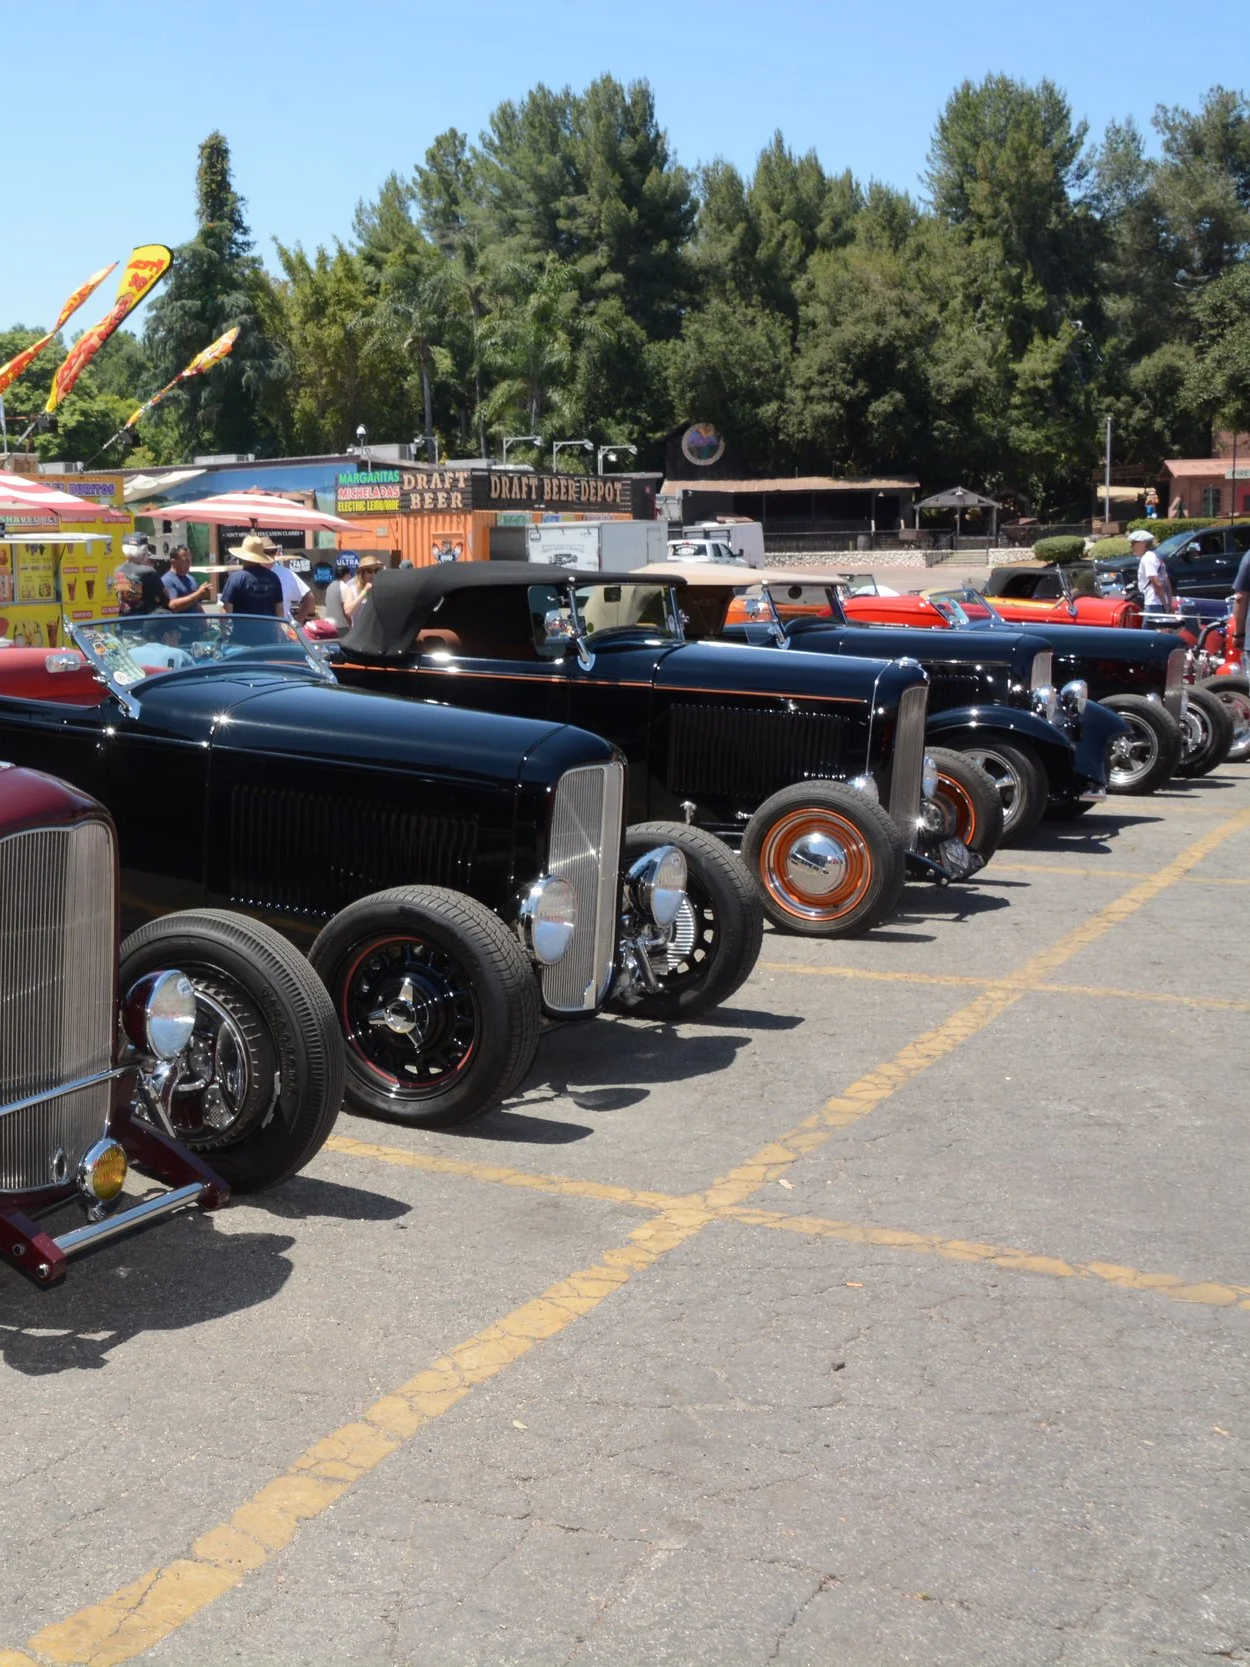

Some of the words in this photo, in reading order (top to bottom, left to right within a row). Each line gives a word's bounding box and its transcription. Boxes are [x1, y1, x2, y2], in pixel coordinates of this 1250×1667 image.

[339, 470, 400, 485] MARGARITAS
[403, 472, 468, 490] DRAFT
[337, 486, 400, 501] MICHELADAS
[490, 474, 538, 499] DRAFT
[543, 476, 576, 501] BEER
[580, 479, 623, 503] DEPOT
[338, 501, 366, 512] ELECTRIC
[410, 492, 463, 509] BEER
